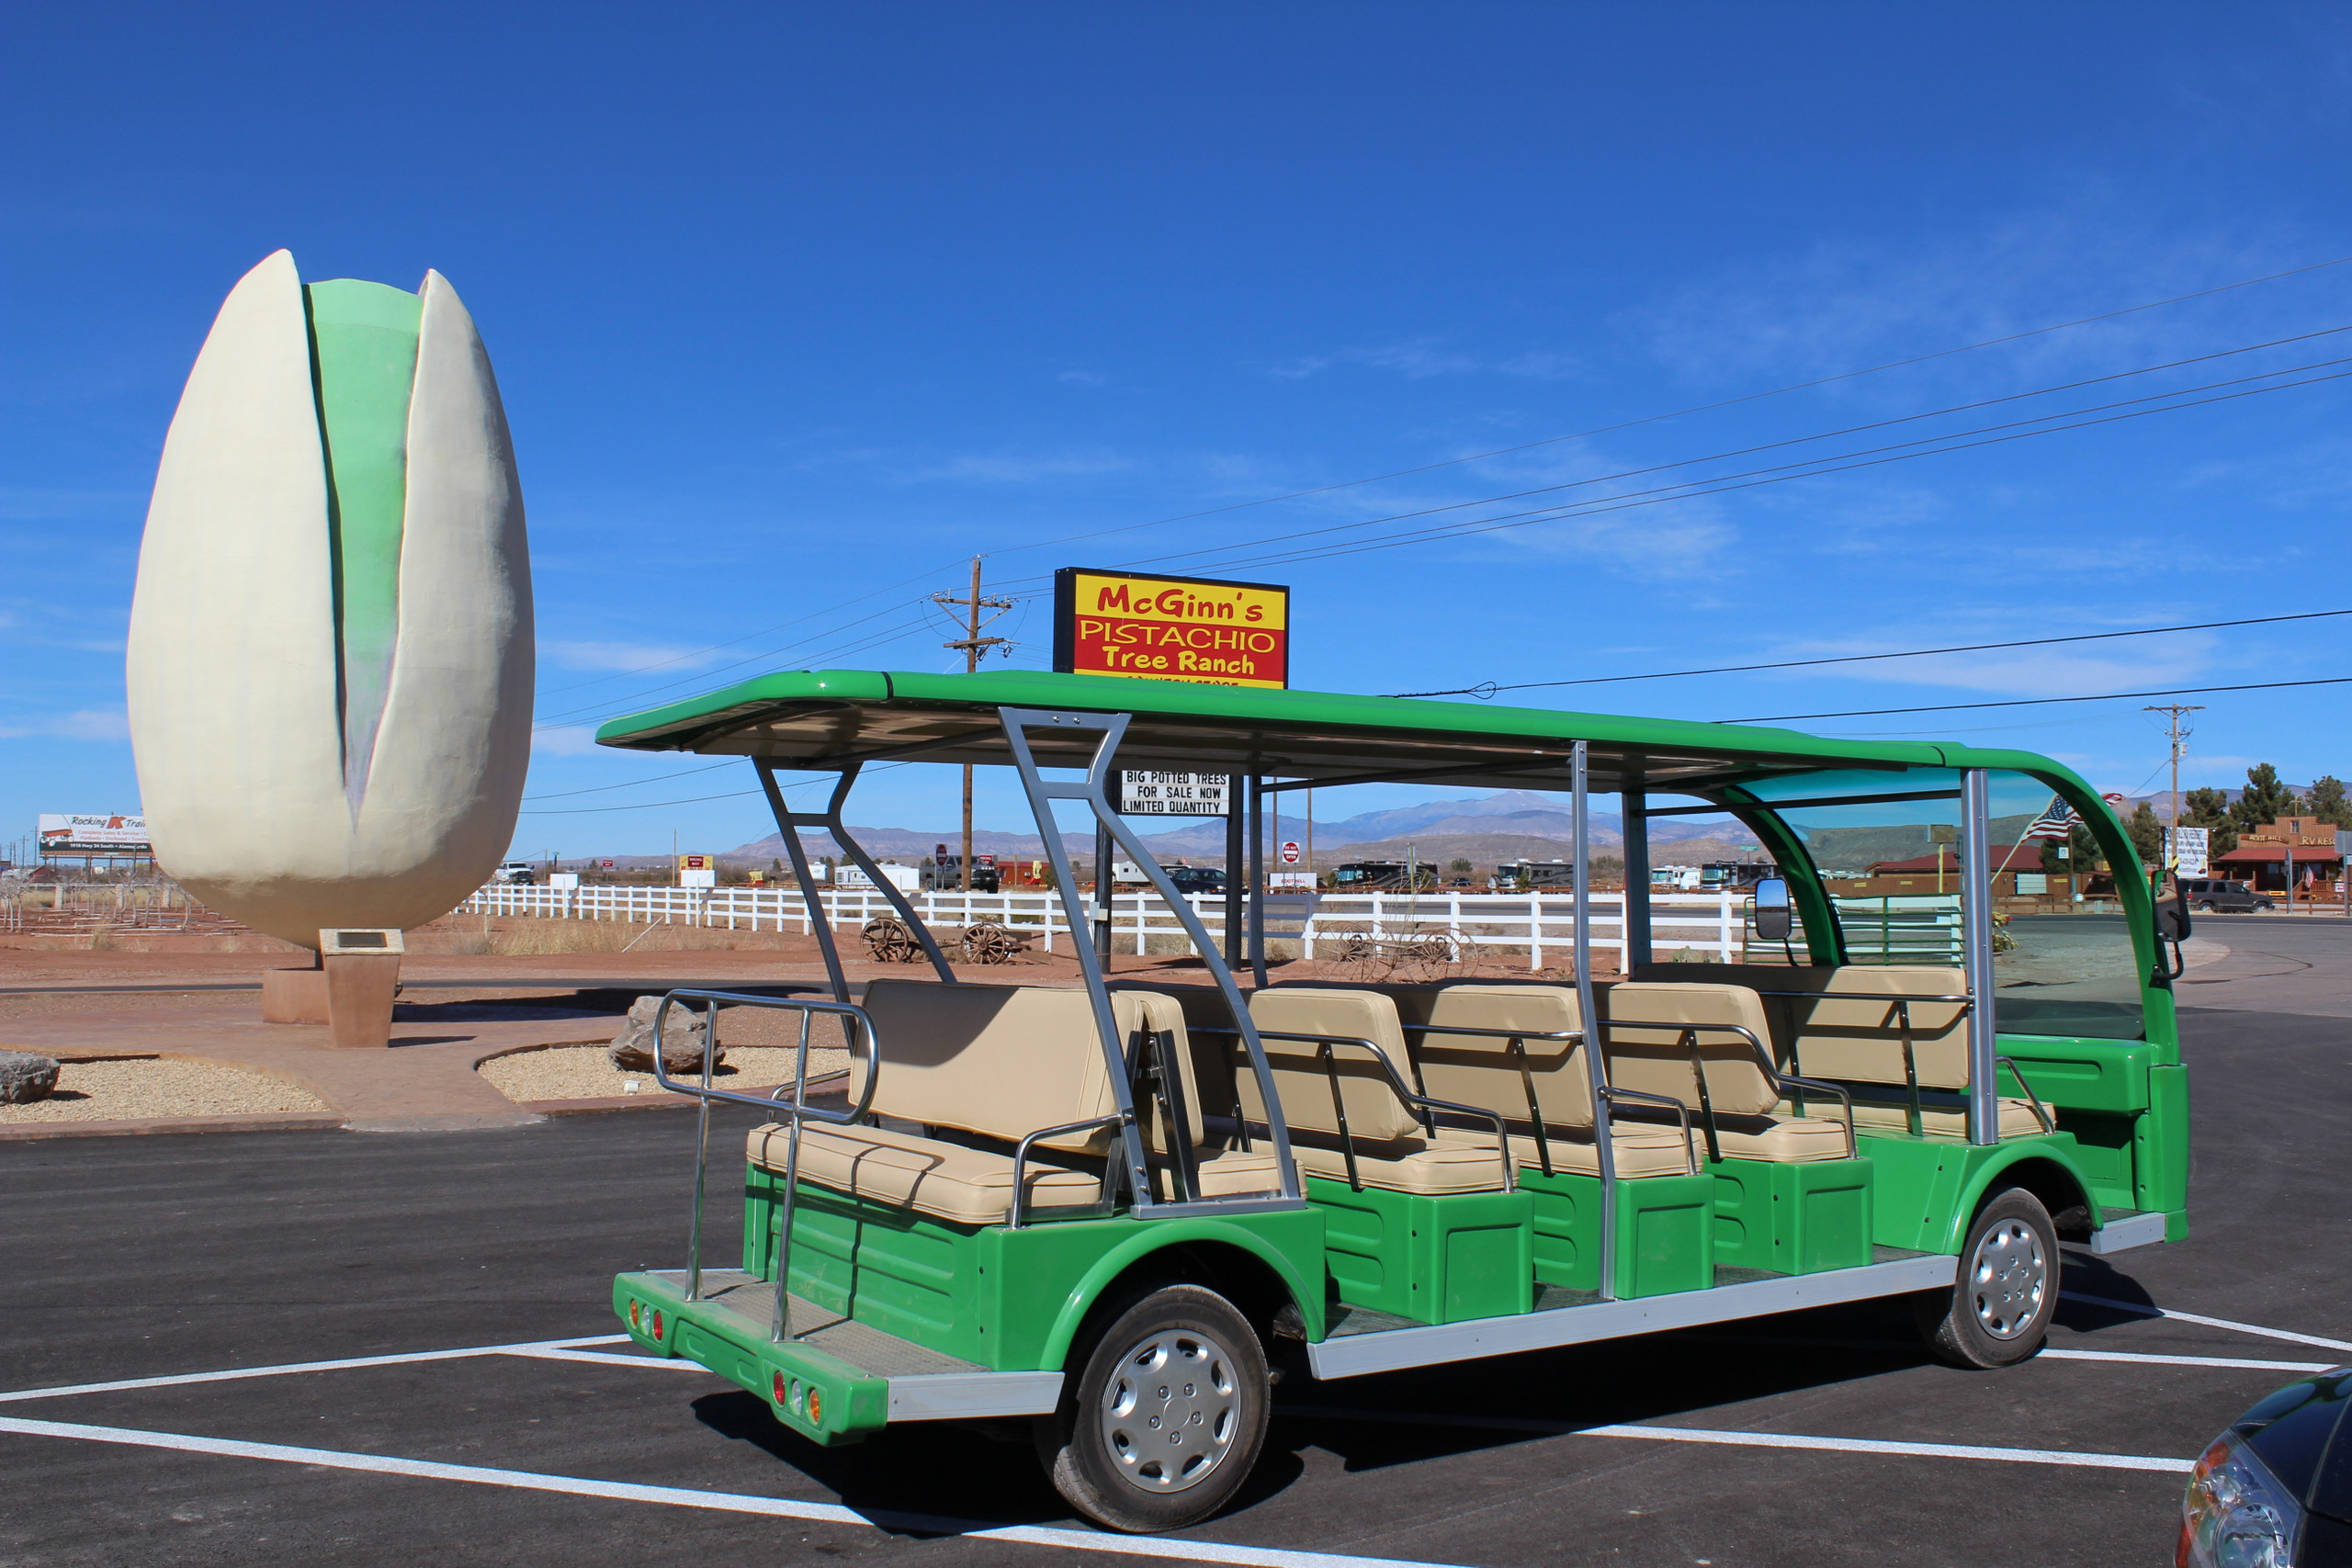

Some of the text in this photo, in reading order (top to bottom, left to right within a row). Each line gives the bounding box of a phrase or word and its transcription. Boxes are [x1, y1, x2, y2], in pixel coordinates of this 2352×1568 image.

[1097, 584, 1264, 622] McGinn's
[1080, 620, 1276, 653] PISTACHIO
[1102, 646, 1255, 675] Tree Ranch
[1126, 772, 1227, 784] BIG POTTED TREES
[1137, 786, 1221, 799] FOR SALE NOW
[1123, 800, 1220, 813] LIMITED QUANTITY
[72, 817, 107, 829] Rocking
[107, 816, 127, 829] K
[2301, 836, 2315, 845] RV
